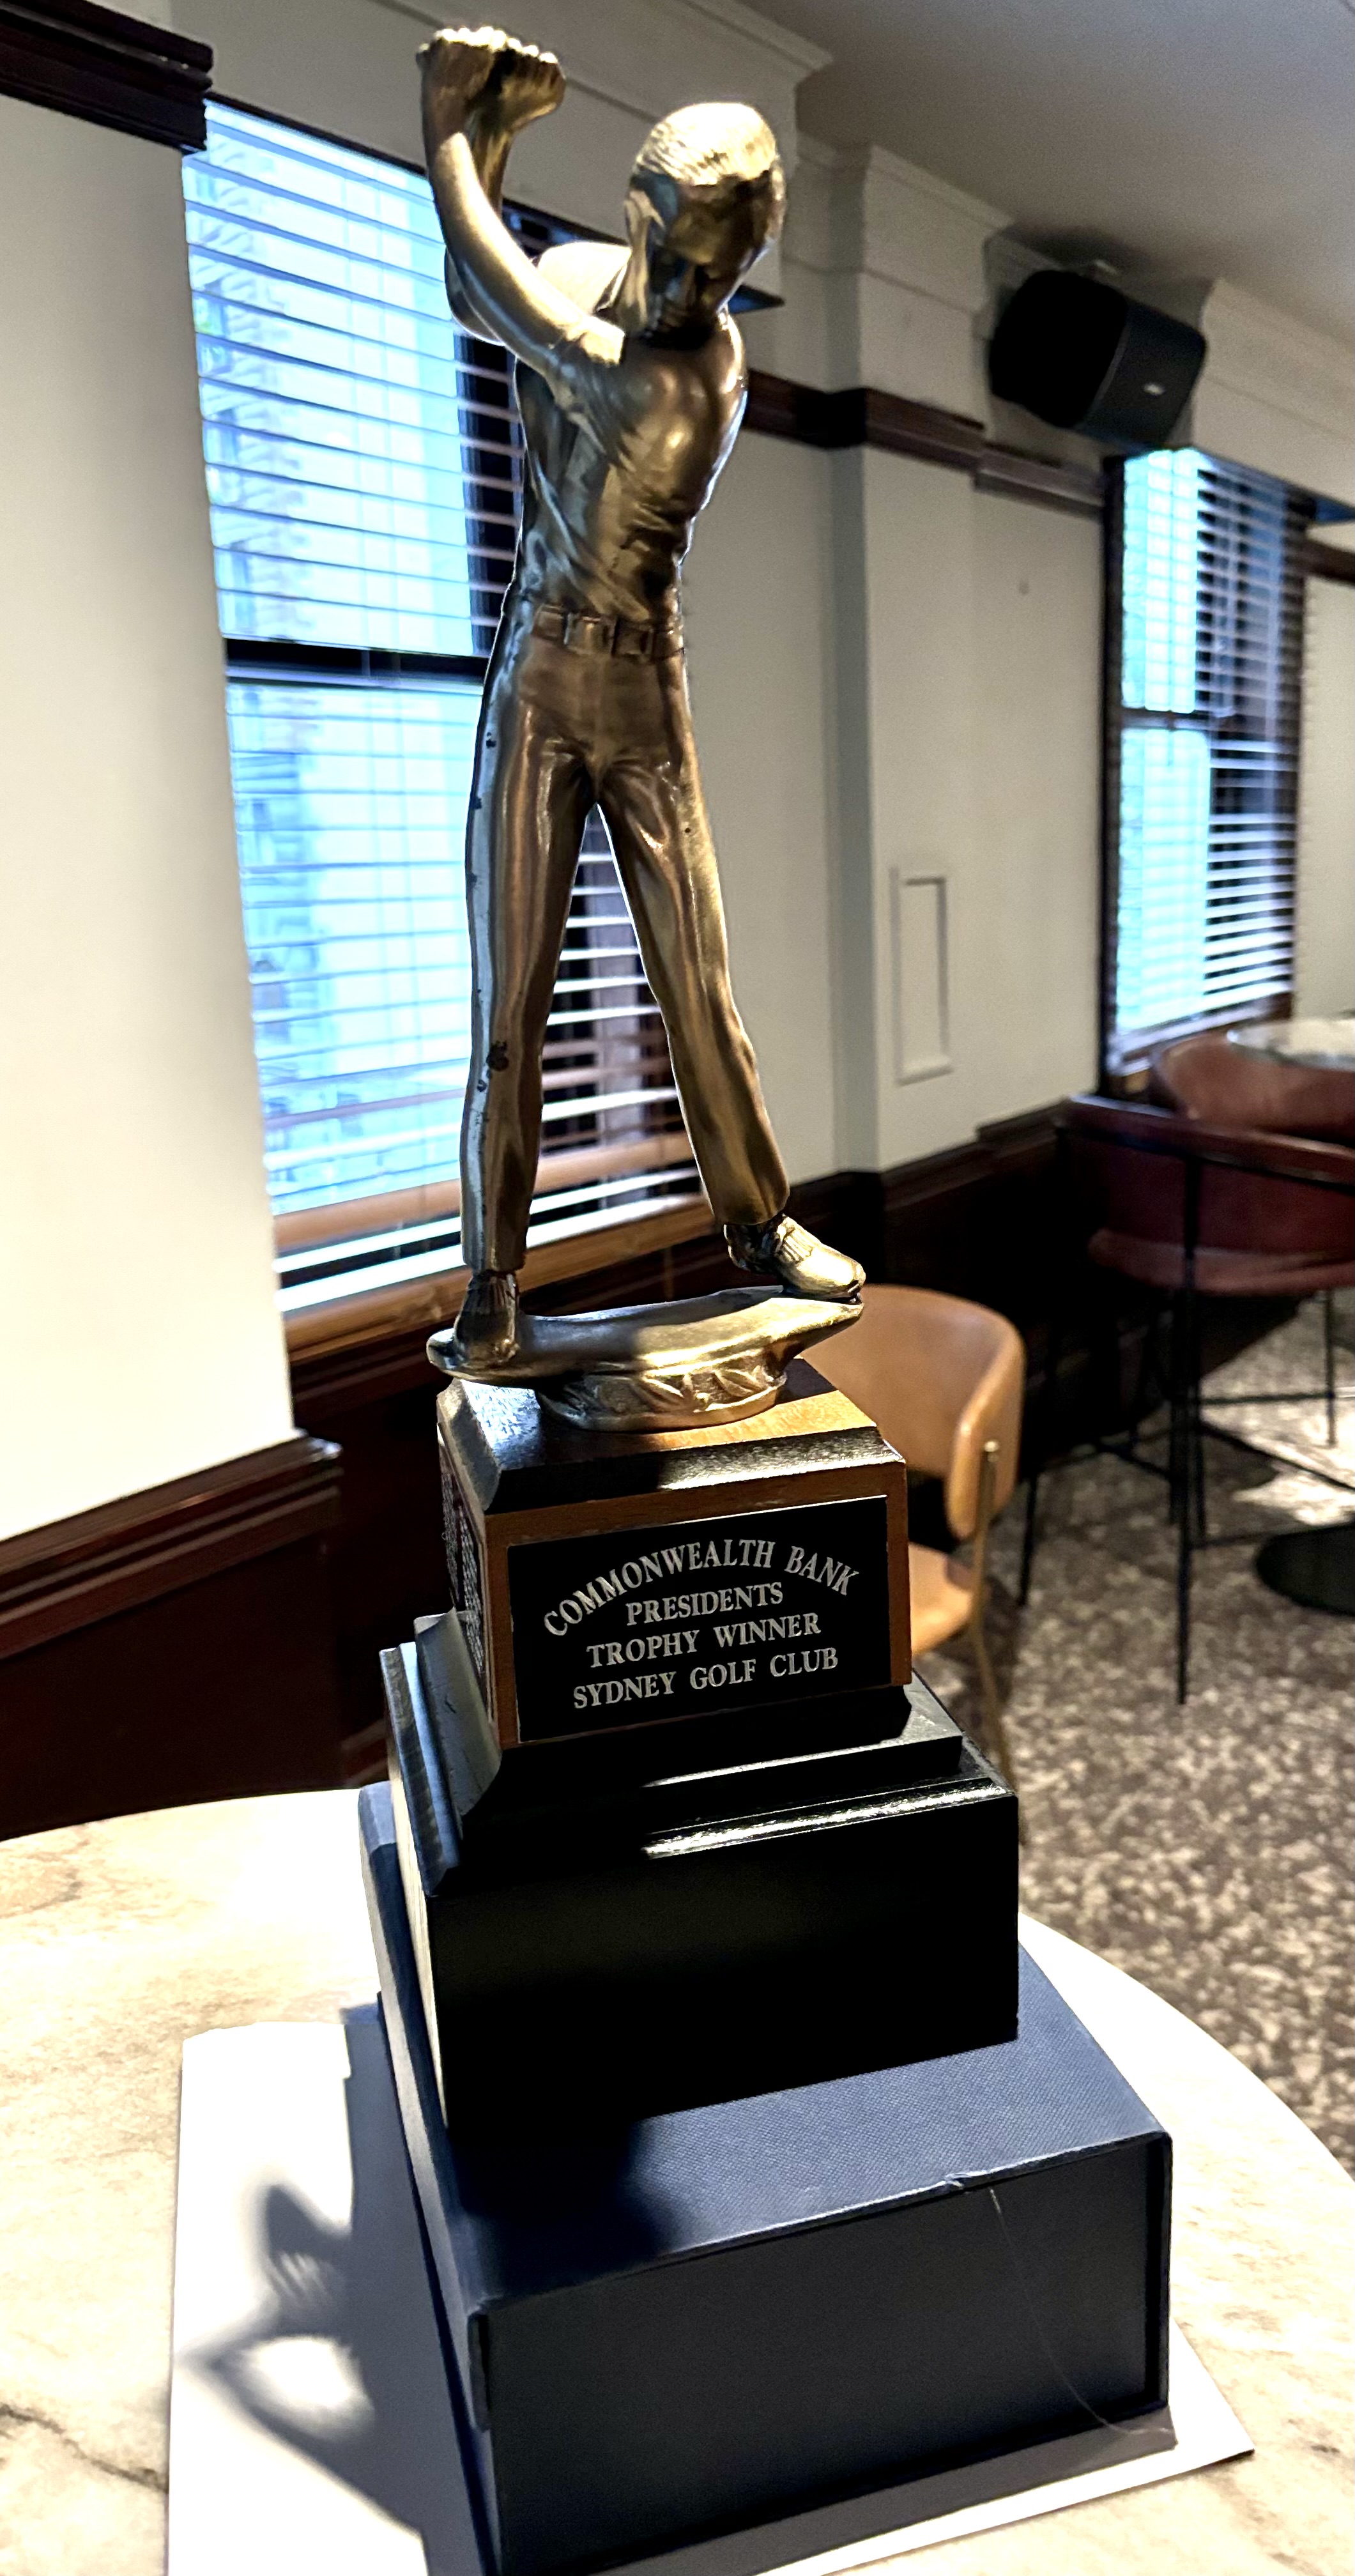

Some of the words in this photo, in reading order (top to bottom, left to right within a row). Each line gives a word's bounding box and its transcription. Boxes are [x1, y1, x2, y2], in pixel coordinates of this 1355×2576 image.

[544, 1540, 776, 1636] COMMONWEALTH
[785, 1546, 859, 1595] BANK
[625, 1582, 783, 1625] PRESIDENTS
[586, 1630, 700, 1667] TROPHY
[713, 1613, 821, 1647] WINNER
[574, 1671, 676, 1708] SYDNEY
[690, 1659, 756, 1689] GOLF
[770, 1648, 838, 1676] CLUB
